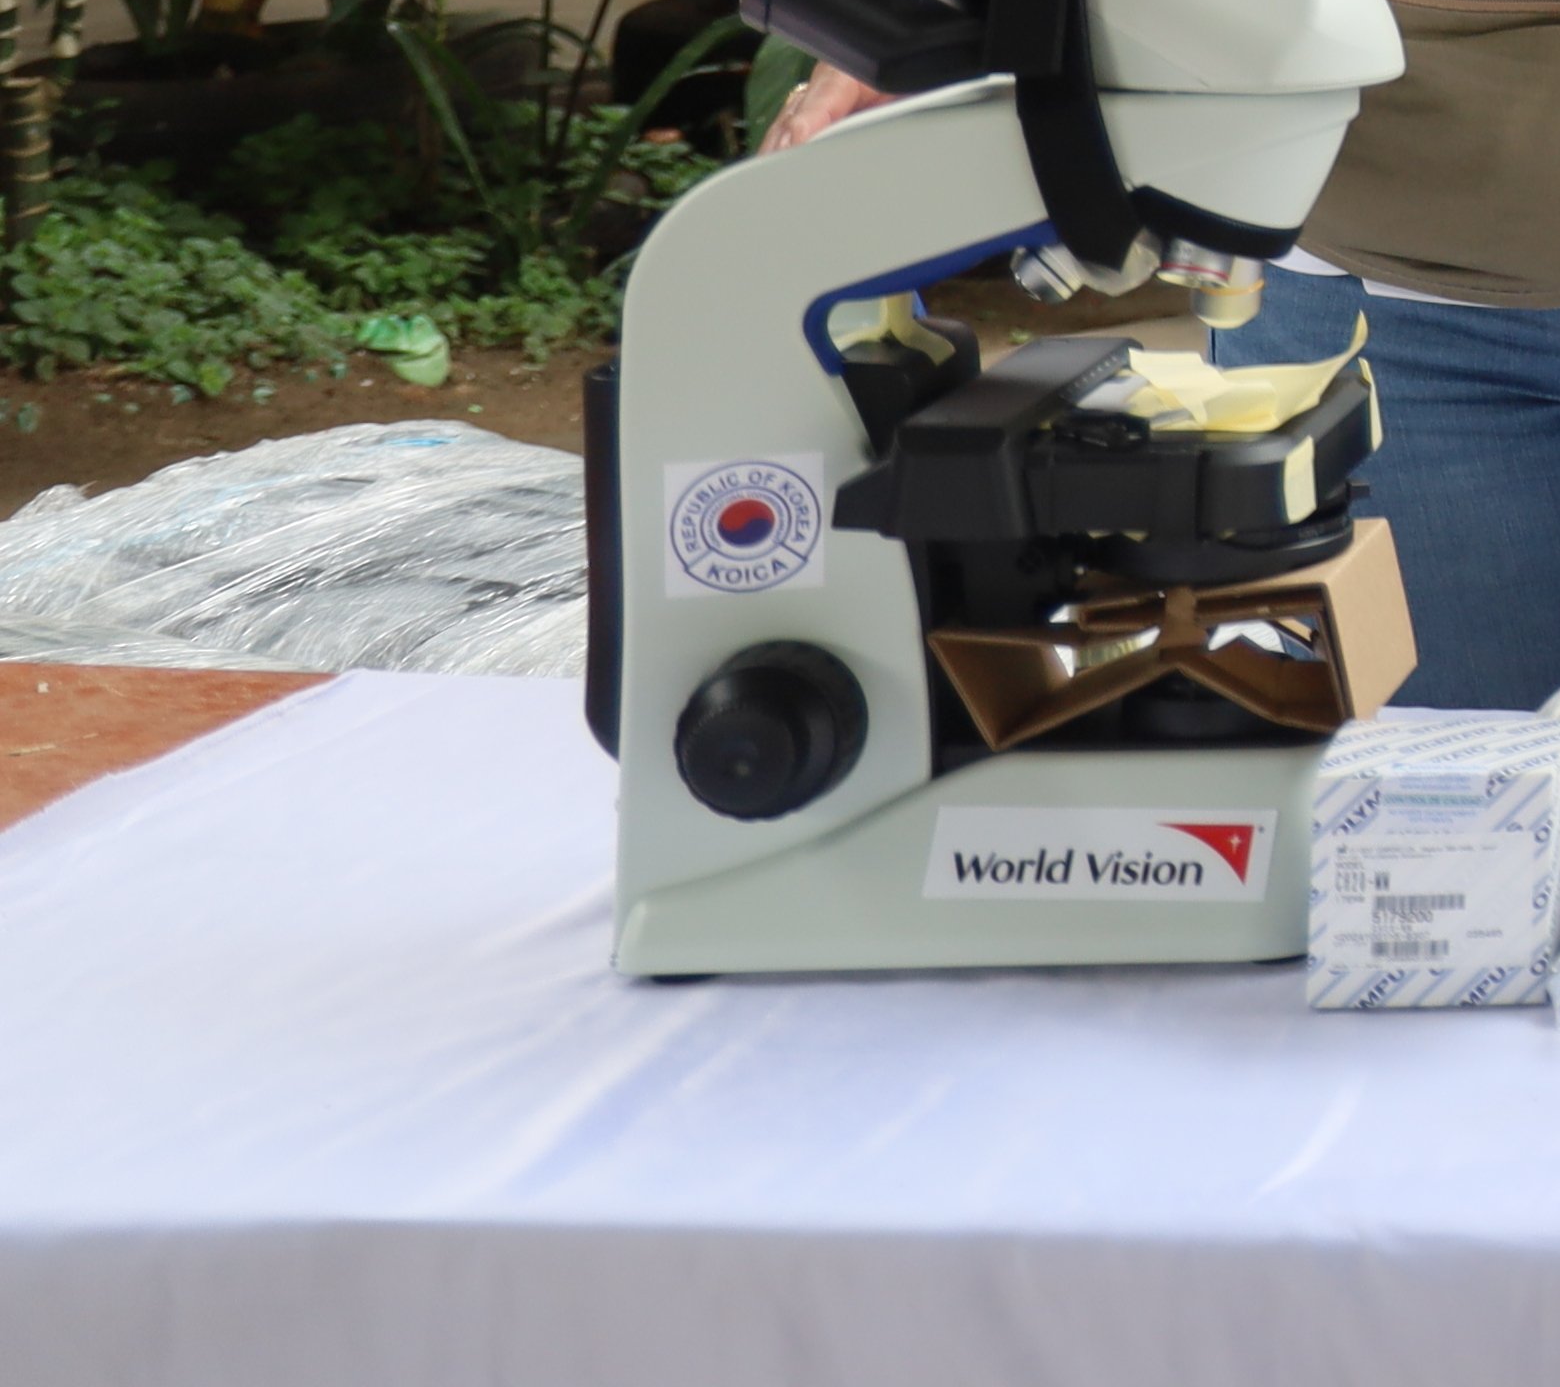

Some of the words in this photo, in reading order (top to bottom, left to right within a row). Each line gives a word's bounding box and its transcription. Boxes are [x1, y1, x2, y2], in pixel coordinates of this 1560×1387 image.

[682, 472, 740, 553] REPUBLIC
[748, 470, 777, 486] OF
[779, 481, 810, 543] KOREA
[706, 558, 789, 585] KOICA
[954, 848, 1074, 884] World
[1086, 850, 1203, 886] Vision
